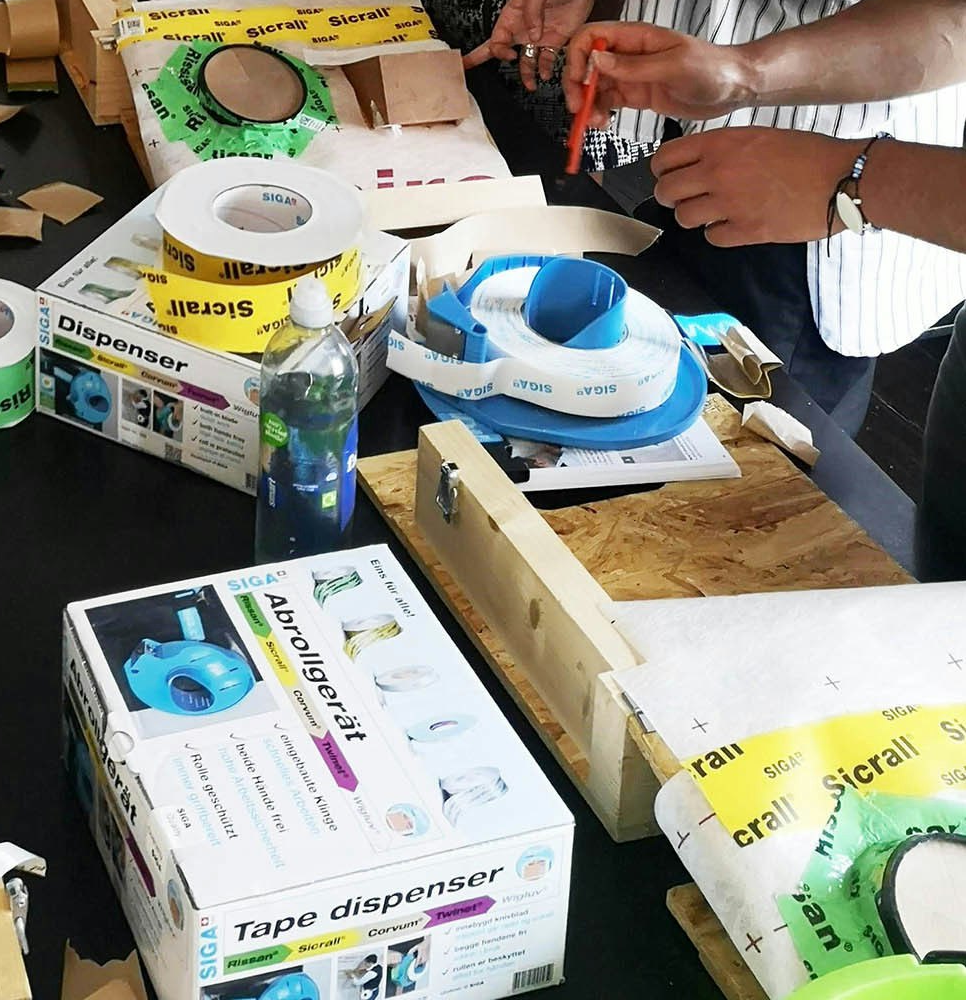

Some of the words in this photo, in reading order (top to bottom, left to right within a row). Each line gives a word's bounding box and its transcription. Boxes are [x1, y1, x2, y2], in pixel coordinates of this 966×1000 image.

[246, 20, 306, 39] Sicrall
[328, 7, 390, 27] Sicrall
[395, 20, 420, 29] SIGA
[312, 35, 336, 43] SIGA
[262, 192, 292, 206] SIGA
[39, 306, 50, 345] SIGA
[170, 300, 254, 320] Sicrall
[58, 314, 189, 373] Dispenser
[465, 382, 494, 398] SIGA
[518, 379, 552, 394] SIGA
[582, 384, 617, 395] SIGA
[227, 572, 280, 592] SIGA
[370, 559, 386, 582] Eins
[385, 581, 399, 598] für
[240, 595, 263, 626] Rissan
[265, 640, 287, 671] Sicrall
[293, 689, 320, 728] Corvum
[264, 592, 367, 742] Abrollgerät
[881, 704, 916, 721] SIGA
[280, 734, 317, 793] eingebaute
[313, 795, 338, 832] Klinge
[763, 756, 801, 779] SIGA
[822, 735, 920, 800] Sicrall
[191, 753, 209, 782] Rolle
[203, 783, 239, 839] geschützt
[235, 743, 256, 773] beide
[271, 809, 290, 833] frei
[177, 808, 192, 829] SIGA
[733, 794, 800, 848] crall
[234, 911, 317, 942] Tape
[330, 866, 505, 921] dispenser
[227, 951, 276, 969] Rissan
[298, 936, 342, 953] Sicrall
[368, 919, 420, 938] Corvum
[435, 902, 479, 920] Twinet
[200, 925, 219, 981] SIGA
